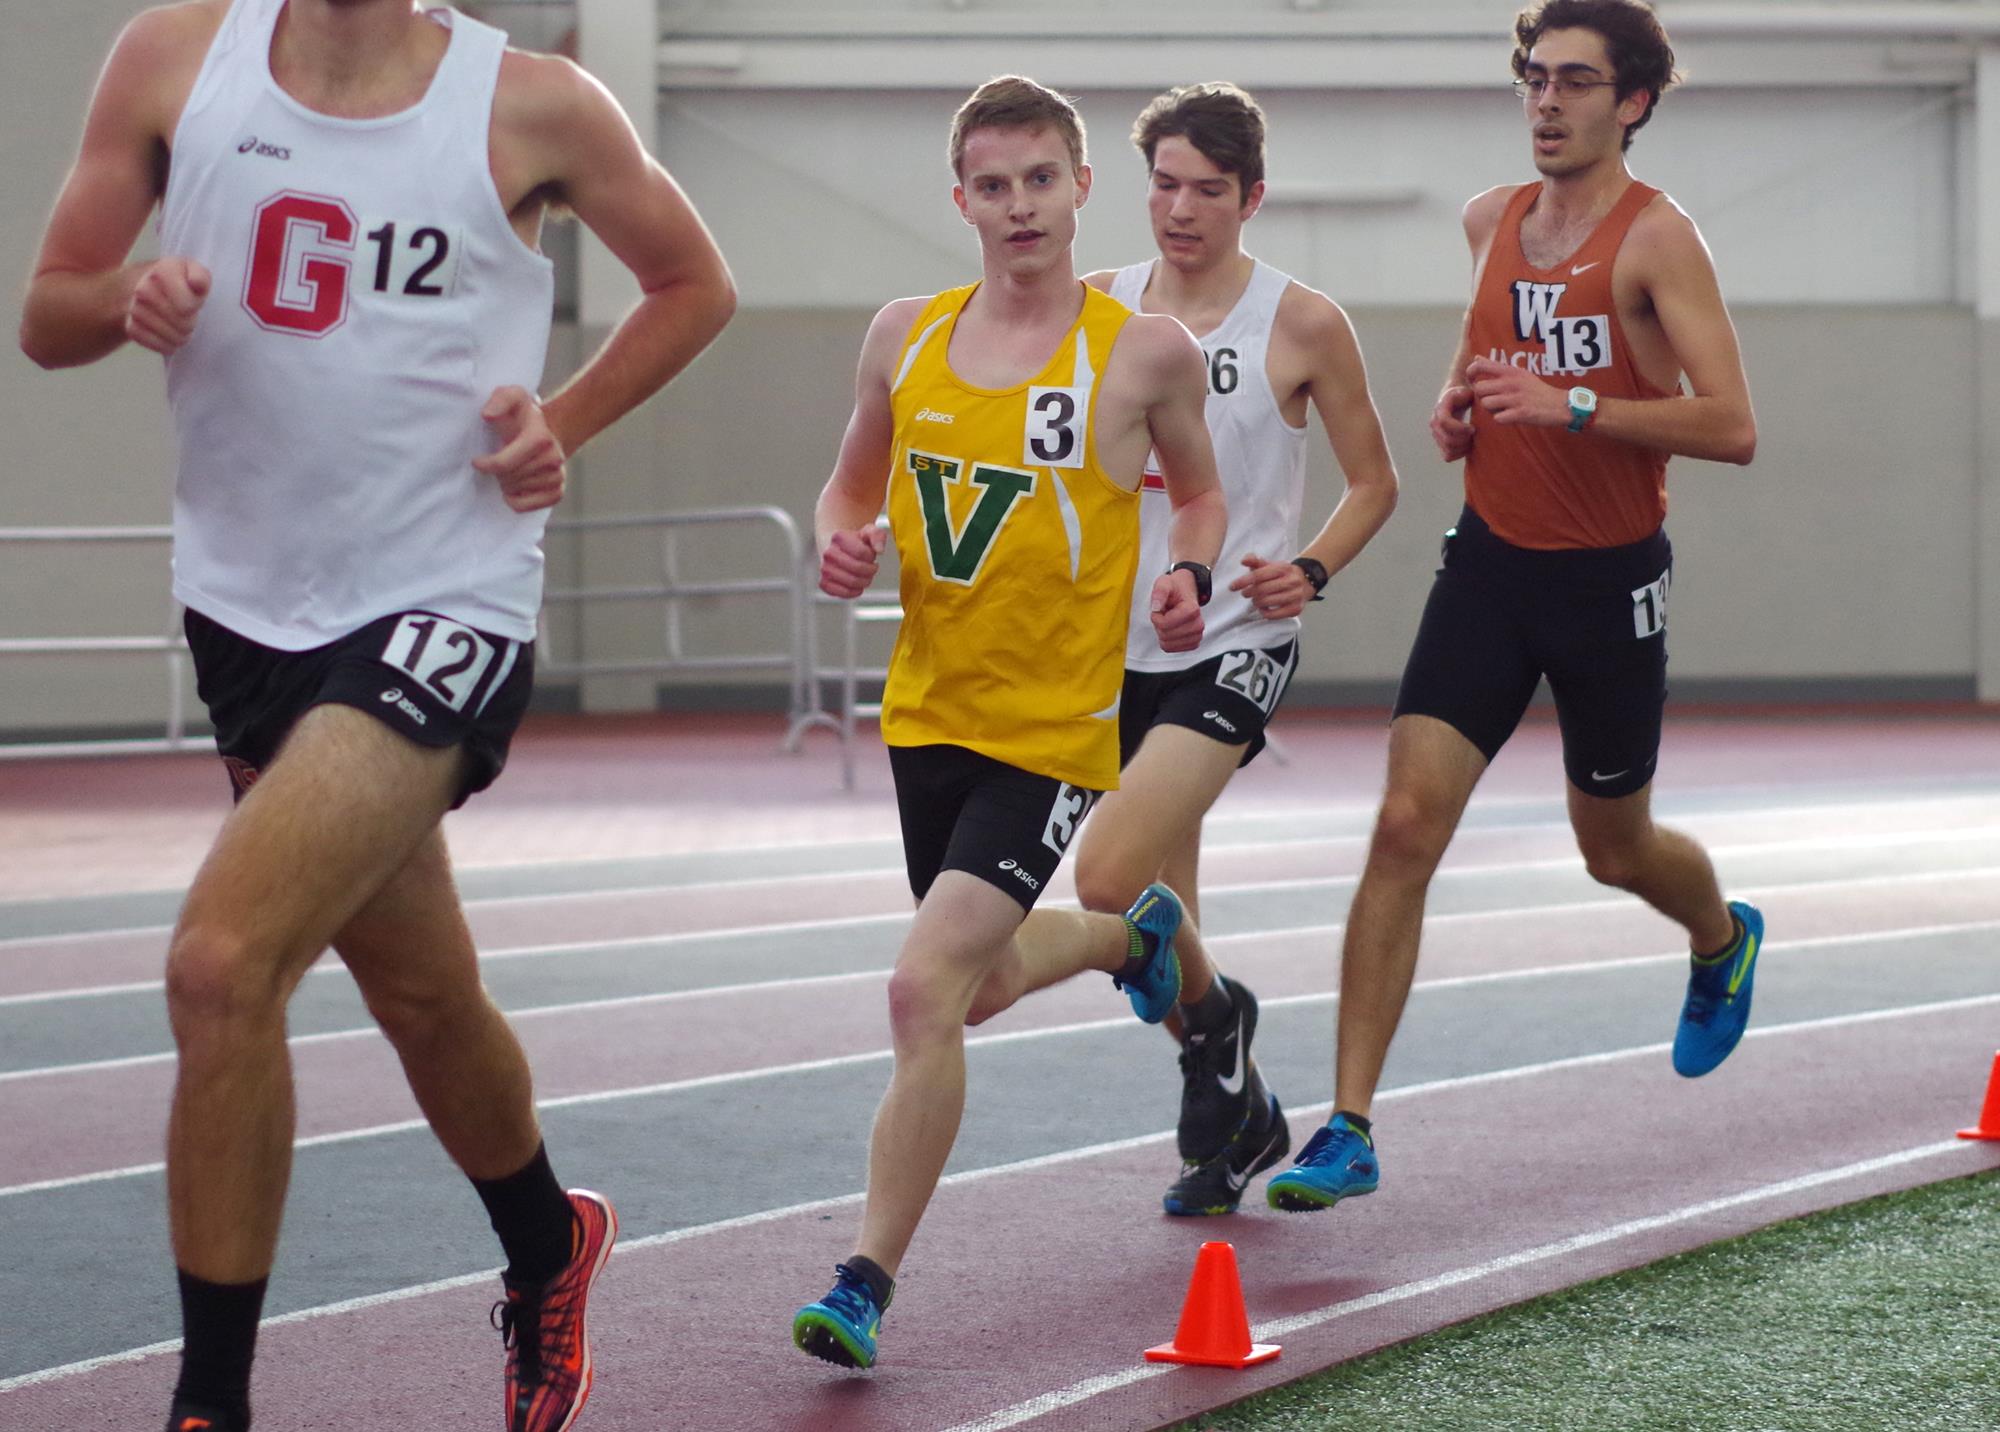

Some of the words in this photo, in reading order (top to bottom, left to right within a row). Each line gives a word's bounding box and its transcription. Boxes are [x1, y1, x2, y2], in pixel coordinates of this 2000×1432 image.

[240, 188, 360, 339] G
[367, 221, 449, 296] 12
[1509, 279, 1568, 344] W
[1549, 318, 1601, 368] 13
[1203, 347, 1239, 395] 6
[1489, 347, 1588, 377] ACKE
[1030, 391, 1075, 461] 3
[914, 455, 953, 475] ST
[906, 447, 1039, 587] V
[403, 619, 478, 703] 12
[1220, 650, 1274, 703] 26
[1051, 785, 1089, 853] 3
[1013, 866, 1040, 890] asics
